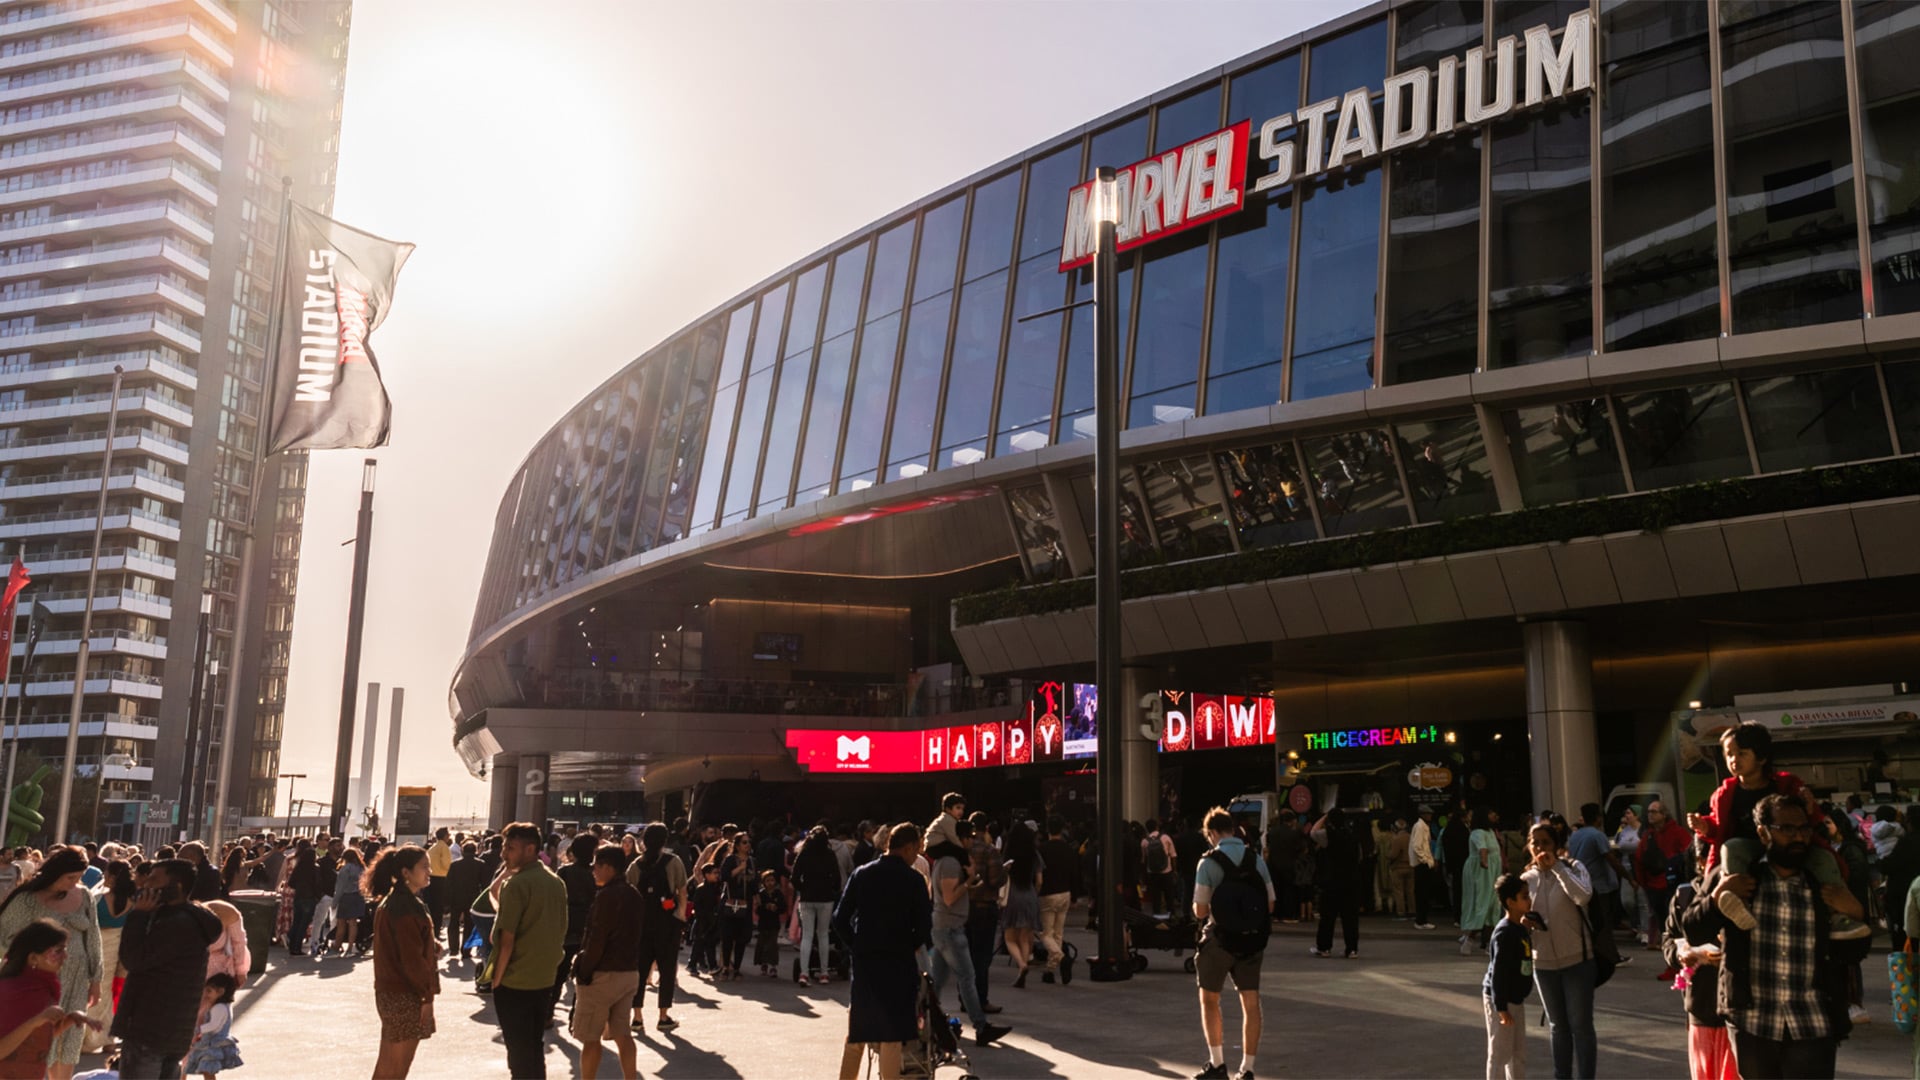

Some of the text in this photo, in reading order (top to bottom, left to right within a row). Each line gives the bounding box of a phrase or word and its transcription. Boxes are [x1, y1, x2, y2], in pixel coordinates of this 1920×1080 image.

[1254, 8, 1596, 192] STADIUM
[294, 249, 340, 401] STADIUM
[1139, 692, 1163, 741] 3
[1848, 708, 1884, 718] BHAVAN
[929, 724, 1056, 765] HAPPY
[1304, 726, 1417, 750] THI ICECREAM
[524, 769, 545, 795] 2
